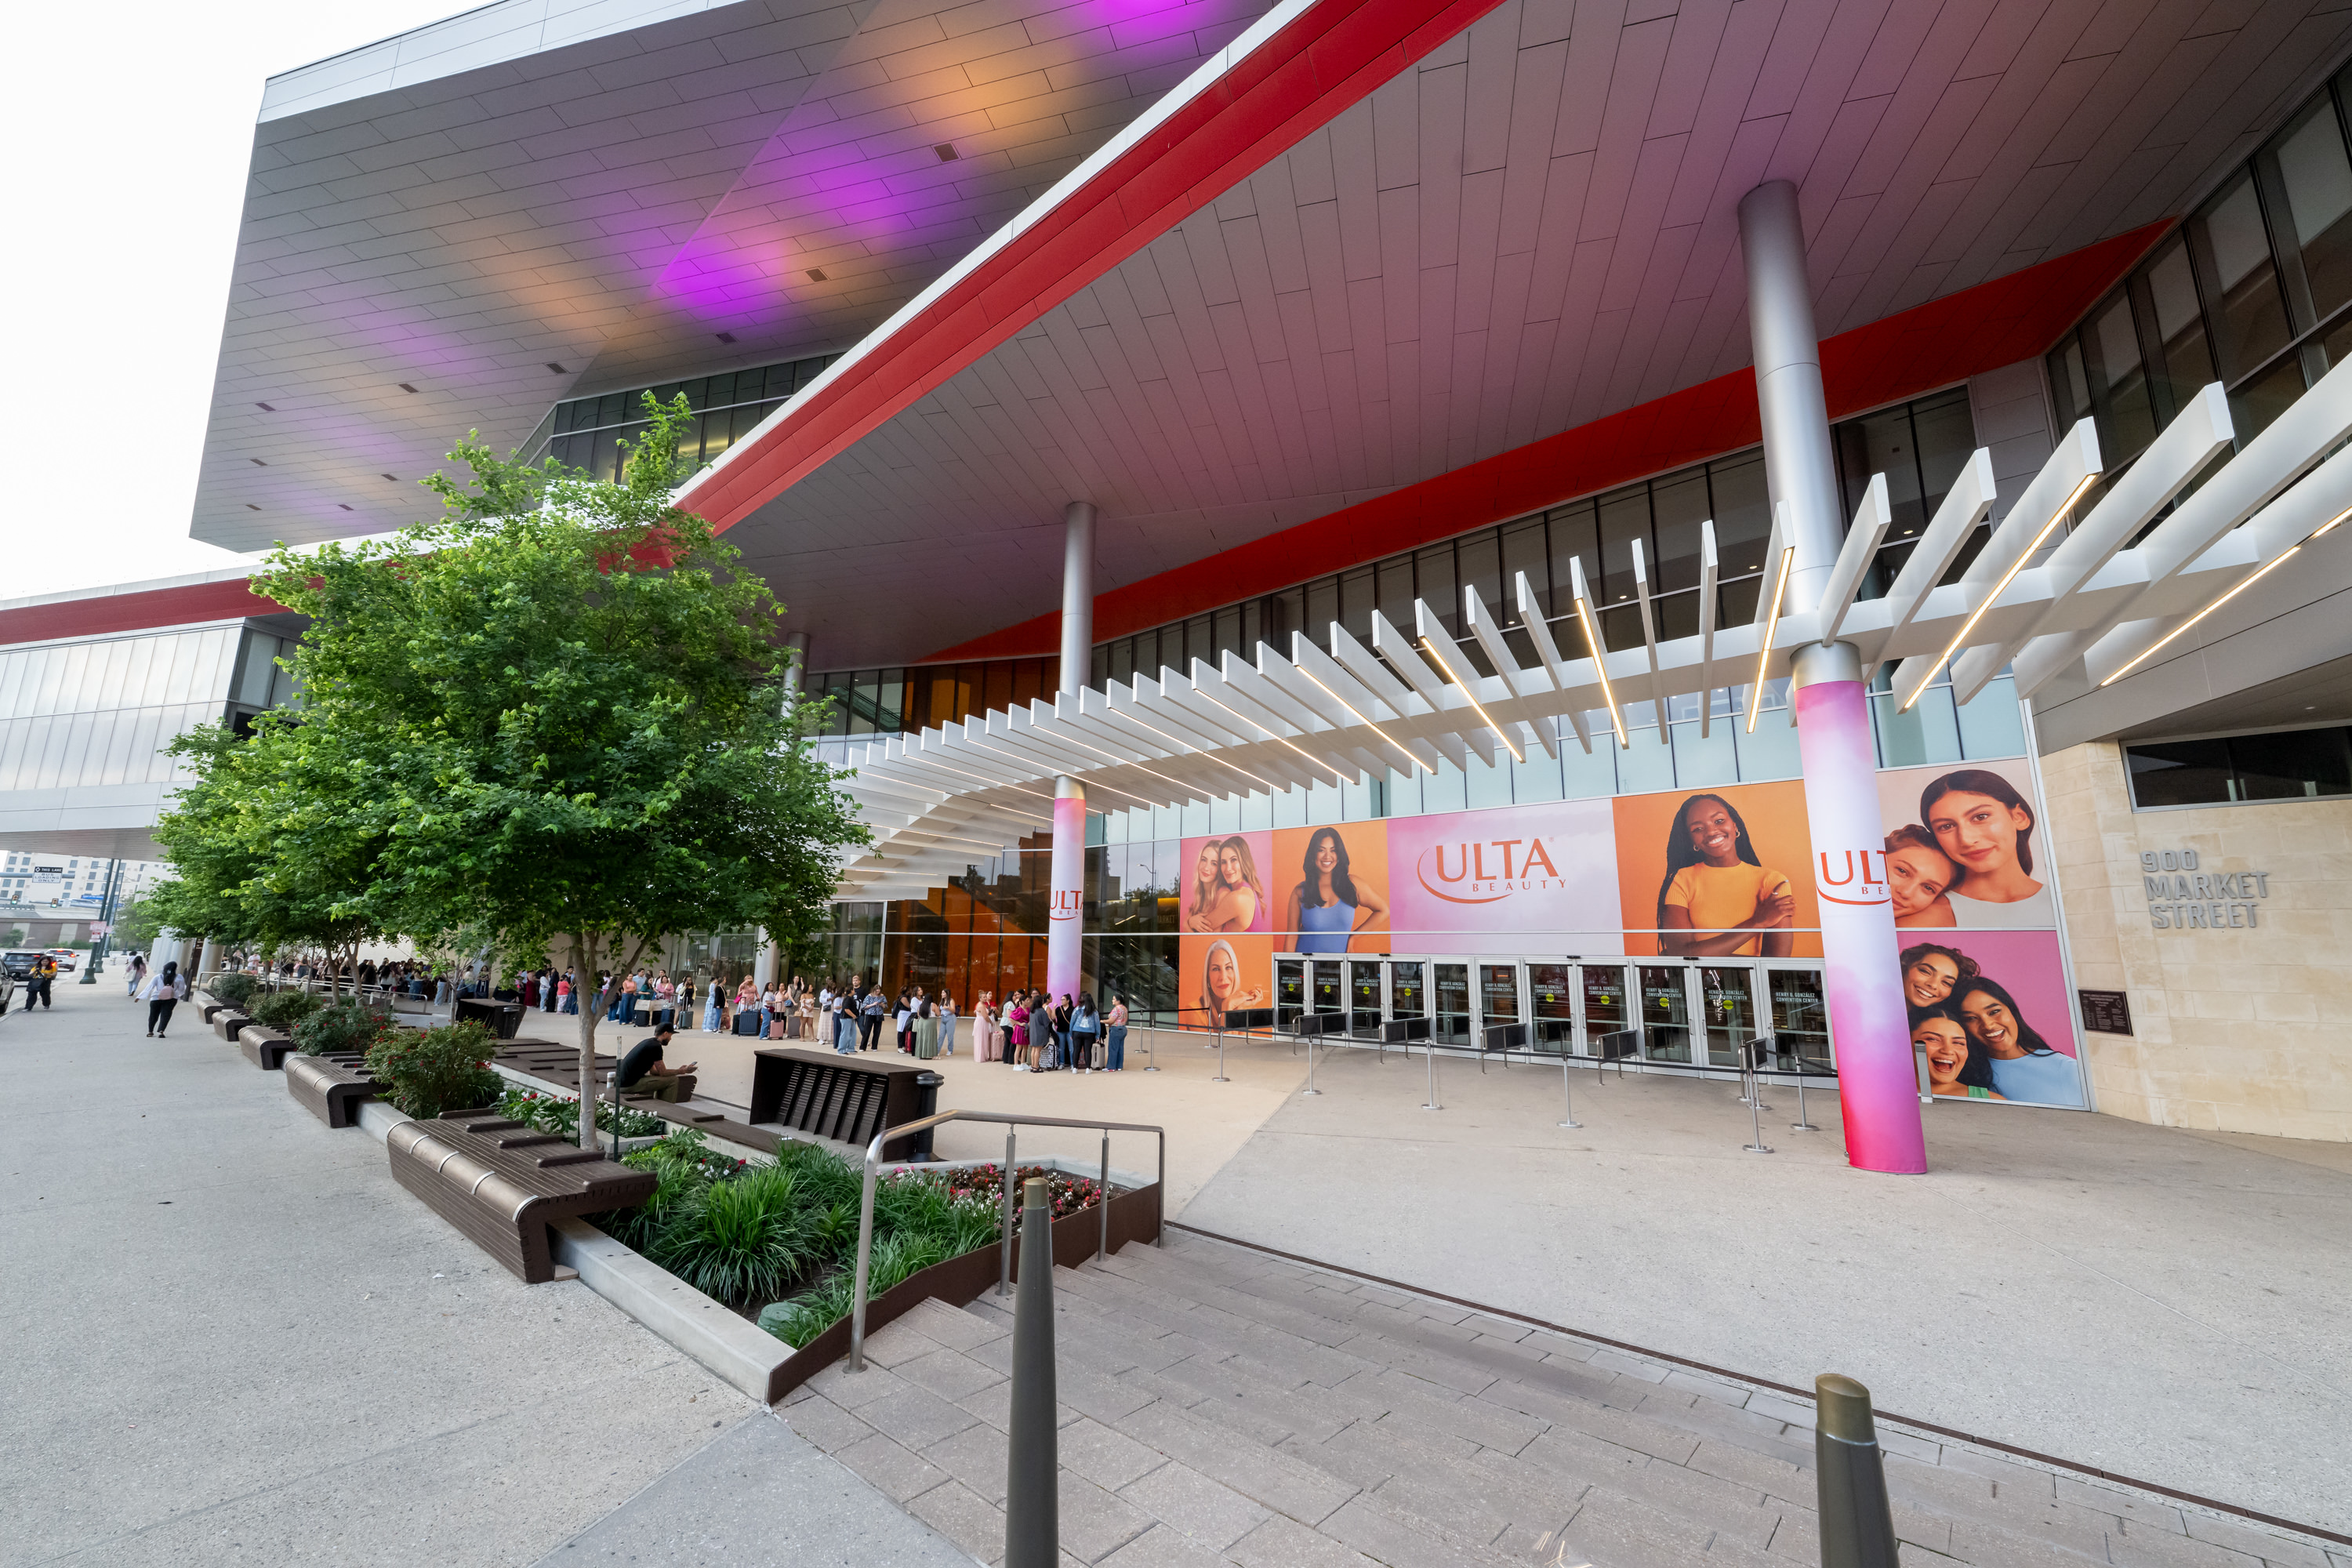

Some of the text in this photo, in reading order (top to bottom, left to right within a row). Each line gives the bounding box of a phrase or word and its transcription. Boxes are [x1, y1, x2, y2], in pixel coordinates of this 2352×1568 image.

[1436, 838, 1559, 883] ULTA
[2140, 848, 2198, 872] 900
[1472, 879, 1566, 892] BEAUTY
[2143, 871, 2268, 902] MARKET
[2150, 902, 2258, 929] STREET
